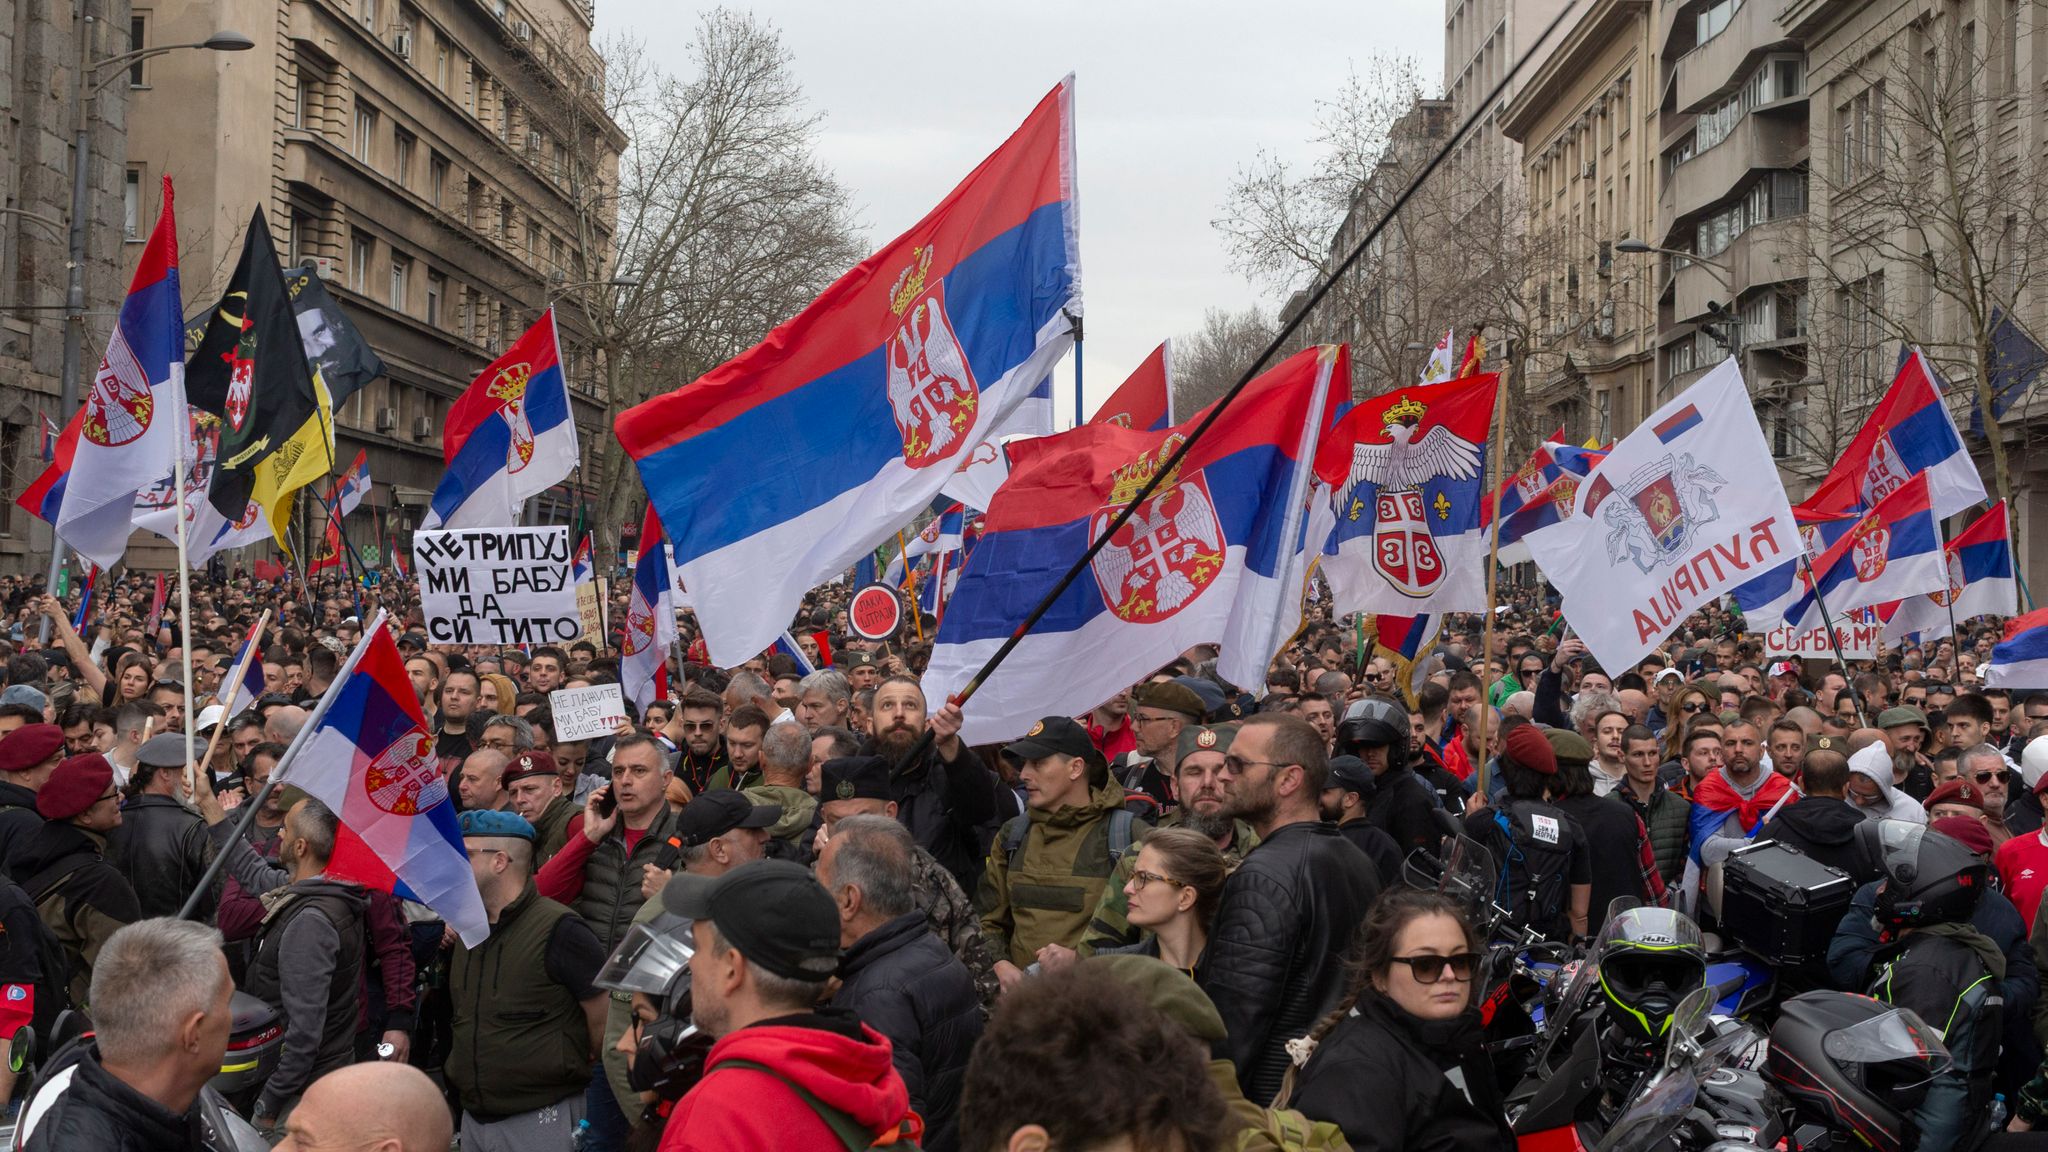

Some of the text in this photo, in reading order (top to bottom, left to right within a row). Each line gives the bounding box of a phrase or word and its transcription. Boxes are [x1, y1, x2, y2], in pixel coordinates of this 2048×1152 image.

[426, 565, 569, 594] МИ БАБУ
[457, 593, 504, 620] ДА
[858, 594, 883, 613] ЛАКИ
[860, 605, 896, 629] ШТРАЈК
[429, 616, 473, 644] СИ
[491, 617, 579, 643] ТИТО
[553, 688, 619, 709] НЕ ЛАЖИТЕ
[555, 705, 601, 727] МИ БАБУ
[1641, 934, 1671, 943] HJC
